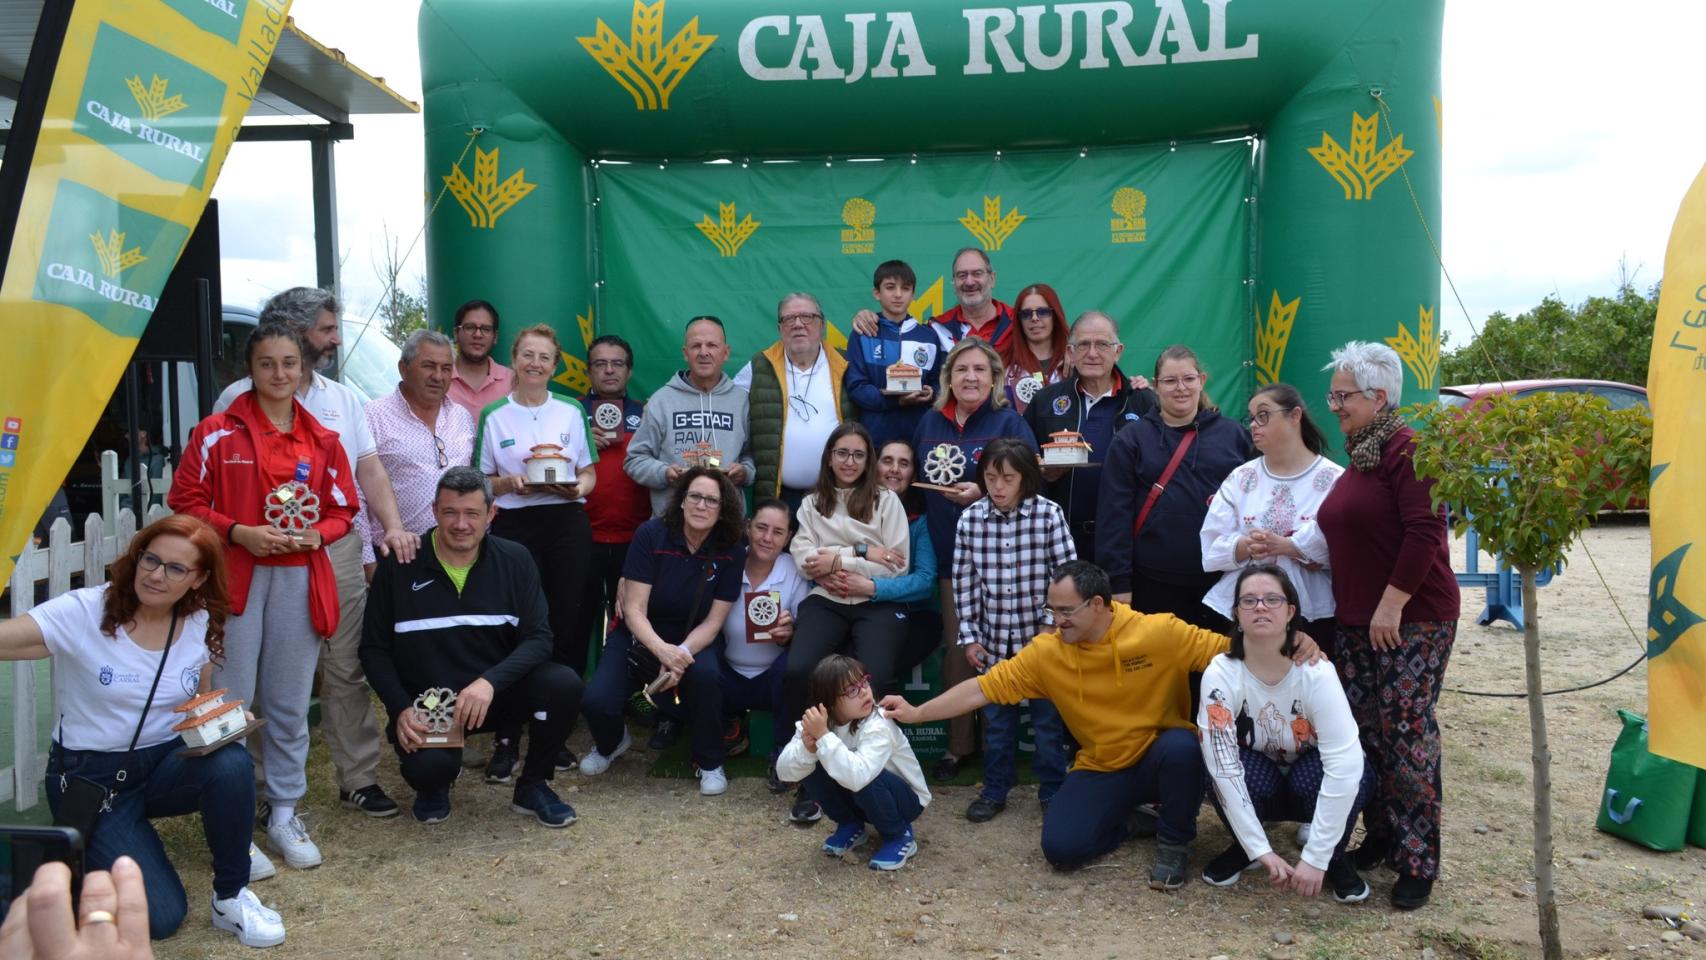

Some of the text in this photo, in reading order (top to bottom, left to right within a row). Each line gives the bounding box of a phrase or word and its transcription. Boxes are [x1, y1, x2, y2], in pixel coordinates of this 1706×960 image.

[737, 0, 1260, 84] CAJA RURAL
[86, 100, 132, 135] CAJA
[137, 124, 204, 163] RURAL
[47, 263, 95, 291] CAJA
[675, 413, 732, 428] G-STAR
[675, 431, 711, 445] RAW
[915, 728, 947, 736] RURAL
